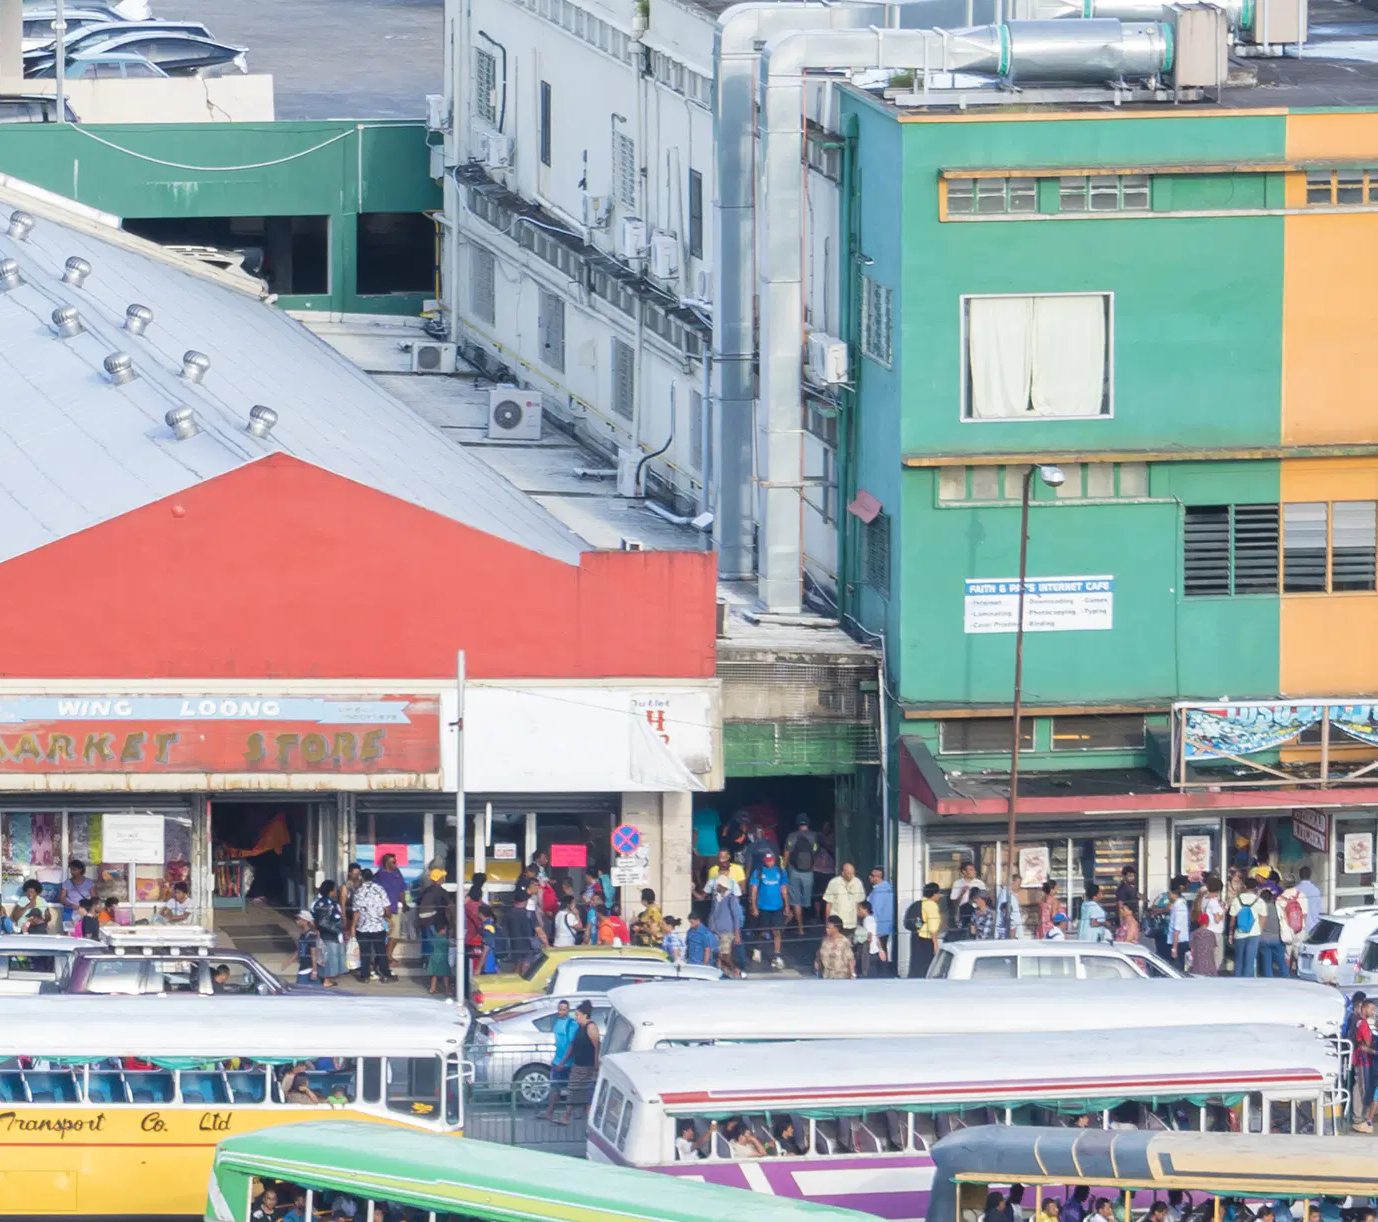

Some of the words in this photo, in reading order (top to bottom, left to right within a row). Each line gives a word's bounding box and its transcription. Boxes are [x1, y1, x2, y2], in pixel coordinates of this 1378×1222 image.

[1038, 582, 1083, 592] INTERNET
[1086, 581, 1109, 591] CAFE
[57, 699, 133, 718] WING
[179, 699, 282, 718] LOONG
[242, 728, 388, 766] STORE
[141, 1112, 169, 1133] Co.
[199, 1112, 232, 1132] Ltd
